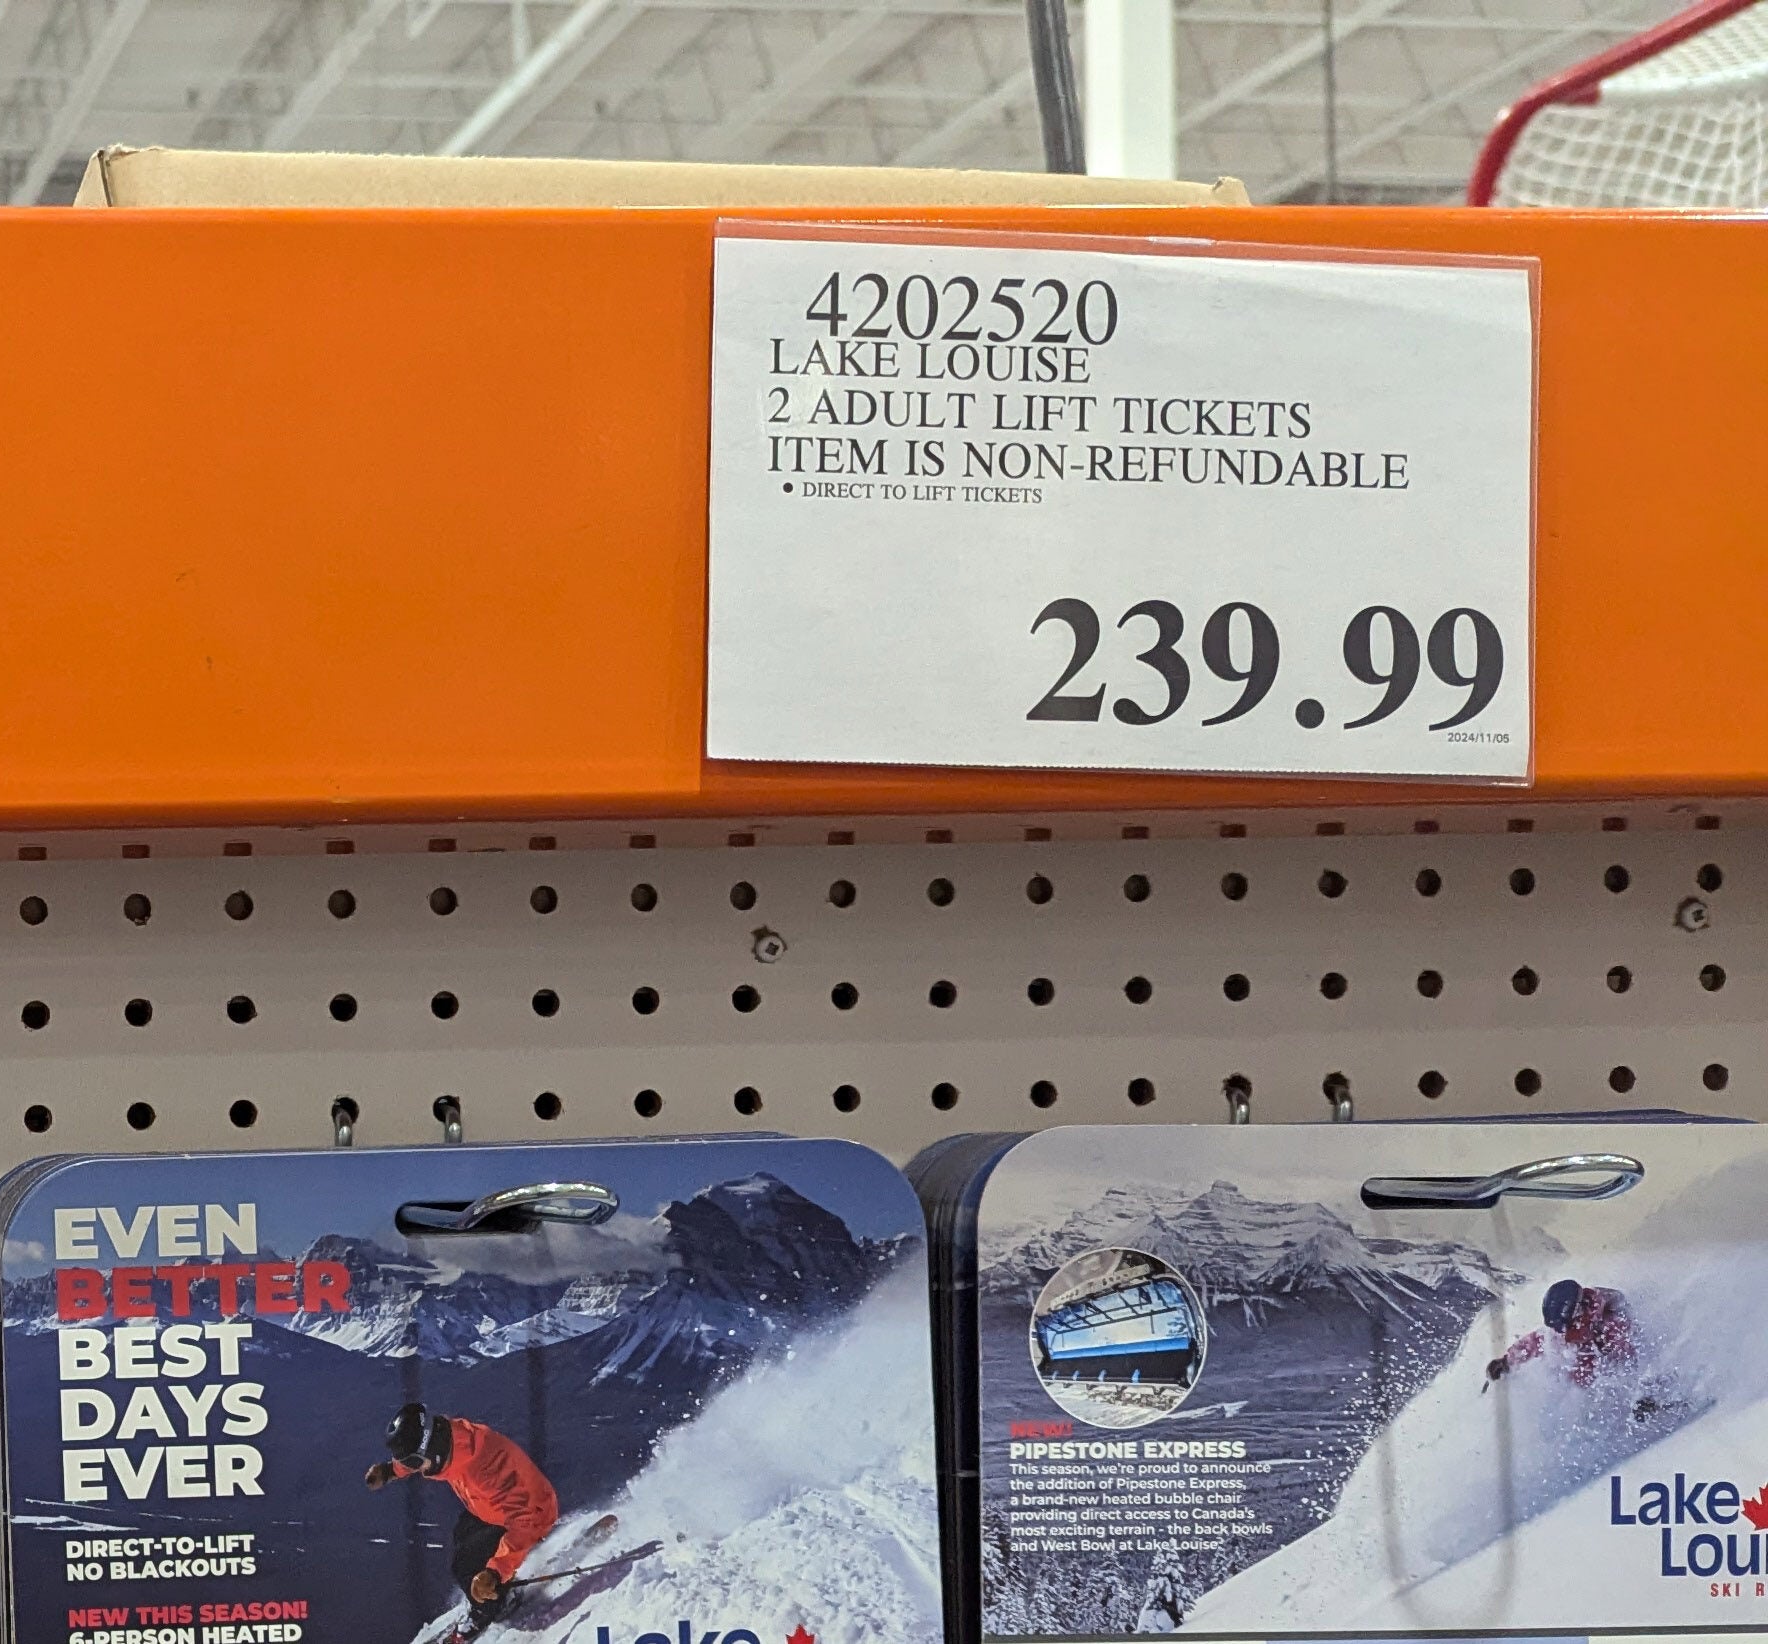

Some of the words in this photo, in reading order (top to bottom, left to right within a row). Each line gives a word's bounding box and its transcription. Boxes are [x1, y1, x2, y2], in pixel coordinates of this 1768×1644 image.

[807, 272, 1117, 348] 4202520
[770, 338, 900, 377] LAKE
[916, 343, 1090, 383] LOUISE
[769, 387, 790, 422] 2
[810, 389, 975, 428] ADULT
[993, 394, 1096, 431] LIFT
[1114, 398, 1310, 438] TICKETS
[768, 436, 888, 474] ITEM
[905, 440, 944, 476] IS
[962, 442, 1409, 490] NON-REFUNDABLE
[803, 482, 874, 498] DIRECT
[881, 485, 906, 499] TO
[913, 485, 956, 501] LIFT
[962, 487, 1042, 503] TICKETS
[1027, 598, 1503, 731] 239.99
[1448, 733, 1509, 743] 2024/11/05
[55, 1203, 257, 1258] EVEN
[56, 1261, 351, 1320] BETTER
[59, 1322, 252, 1380] BEST
[60, 1383, 268, 1441] DAYS
[1010, 1443, 1137, 1459] PIPESTONE
[1144, 1441, 1246, 1458] EXPRESS
[62, 1443, 264, 1503] EVER
[1011, 1464, 1039, 1475] This
[1042, 1465, 1093, 1476] season,
[1097, 1464, 1134, 1474] we're
[1138, 1463, 1179, 1477] proud
[1183, 1464, 1198, 1473] to
[1201, 1463, 1271, 1473] announce
[1010, 1479, 1034, 1490] the
[1037, 1479, 1096, 1490] addition
[1099, 1478, 1114, 1489] of
[1117, 1478, 1187, 1492] Pipestone
[1190, 1477, 1246, 1490] Express,
[1010, 1496, 1018, 1505] a
[1022, 1494, 1098, 1505] brand-new
[1103, 1493, 1150, 1505] heated
[1154, 1493, 1203, 1504] bubble
[1207, 1493, 1241, 1504] chair
[1611, 1473, 1740, 1525] Lake
[1011, 1510, 1076, 1523] providing
[1080, 1509, 1122, 1520] direct
[1125, 1510, 1170, 1520] access
[1174, 1509, 1189, 1519] to
[1192, 1507, 1254, 1520] Canada's
[1011, 1526, 1045, 1537] most
[1050, 1525, 1105, 1538] exciting
[1109, 1524, 1155, 1535] terrain
[1168, 1524, 1191, 1535] the
[1195, 1523, 1228, 1535] back
[1232, 1523, 1273, 1535] bowls
[66, 1535, 254, 1559] DIRECT-TO-LIFT
[1010, 1540, 1037, 1552] and
[1041, 1540, 1077, 1551] West
[1082, 1539, 1115, 1551] Bowl
[1119, 1540, 1133, 1550] at
[1137, 1539, 1168, 1550] Lake
[67, 1563, 103, 1581] NO
[110, 1557, 256, 1579] BLACKOUTS
[1711, 1583, 1739, 1597] SKI
[69, 1608, 129, 1627] NEW
[136, 1605, 193, 1624] THIS
[200, 1601, 307, 1622] SEASON!
[203, 1624, 301, 1644] HEATED
